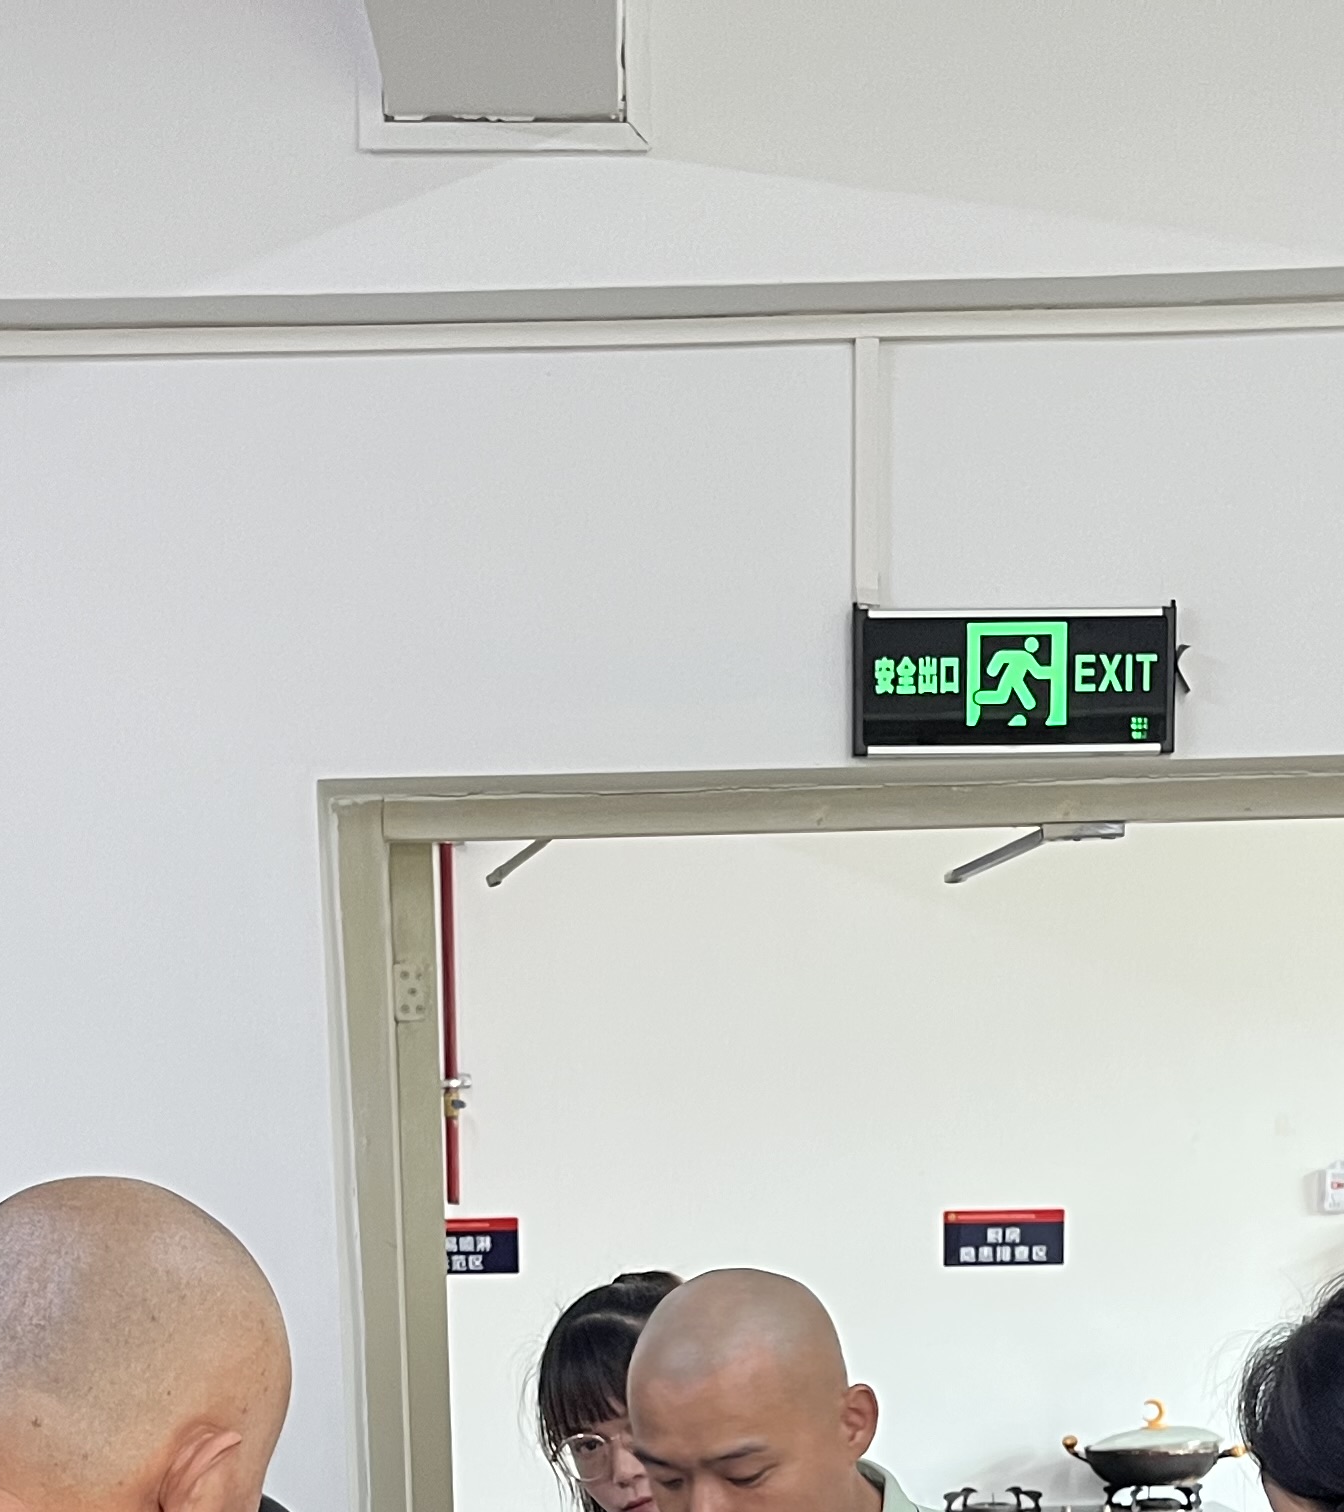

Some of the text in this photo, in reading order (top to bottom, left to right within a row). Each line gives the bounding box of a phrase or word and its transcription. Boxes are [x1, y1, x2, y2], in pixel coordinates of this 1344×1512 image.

[874, 656, 960, 695] 安全出口
[1074, 653, 1158, 692] EXIT
